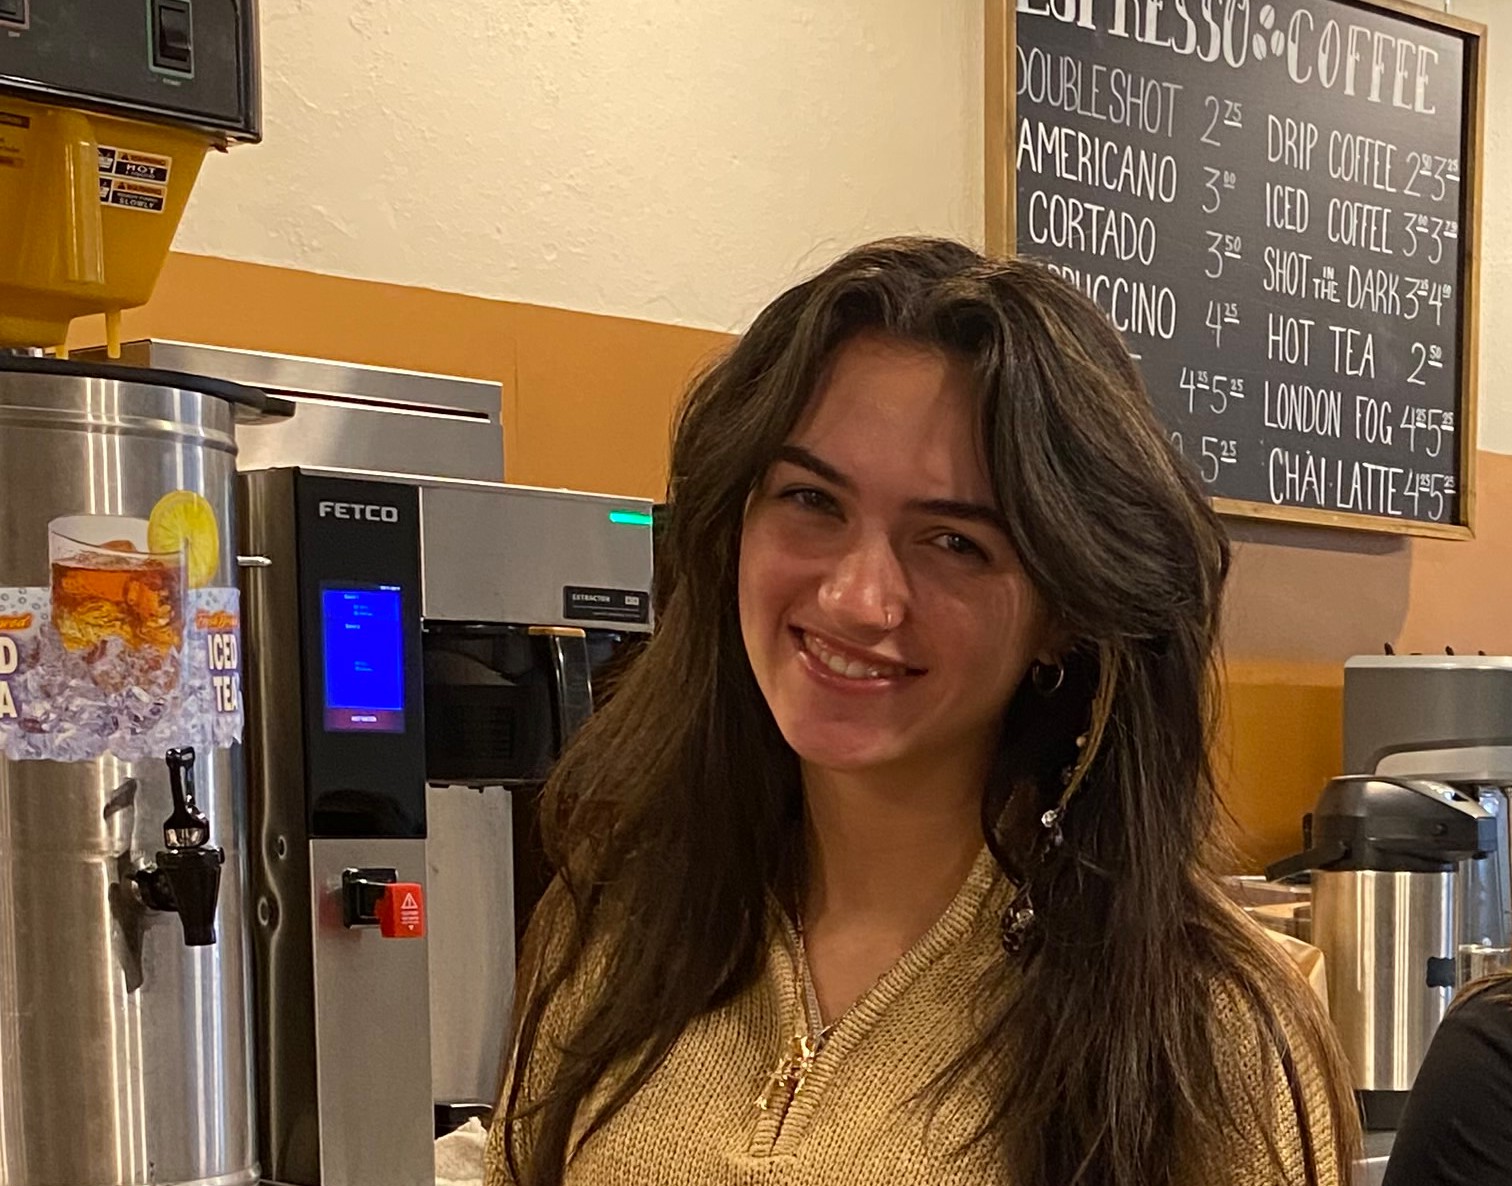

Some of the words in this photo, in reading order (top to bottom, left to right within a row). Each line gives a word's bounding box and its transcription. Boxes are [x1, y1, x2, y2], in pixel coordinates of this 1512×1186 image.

[1017, 0, 1250, 68] RESSO
[1287, 10, 1439, 116] COFFEE
[1016, 118, 1177, 203] AMERICANO
[1268, 114, 1319, 172] DRIP
[1328, 130, 1398, 193] COFFEE
[1029, 190, 1157, 266] CORTADO
[1265, 182, 1310, 234] ICED
[1327, 197, 1394, 255] COFFEE
[1263, 246, 1313, 299] SHOT
[1312, 277, 1341, 303] THE
[1321, 266, 1335, 280] IN
[1346, 264, 1401, 316] DARK
[1267, 312, 1316, 367] HOT
[1328, 325, 1376, 379] TEA
[1264, 380, 1342, 438] LONDON
[1355, 395, 1393, 446] FOG
[319, 500, 398, 523] FETCO
[1268, 447, 1327, 508] CHAI
[1336, 459, 1404, 515] LATTE
[207, 633, 238, 670] ICED
[212, 674, 239, 712] TEA
